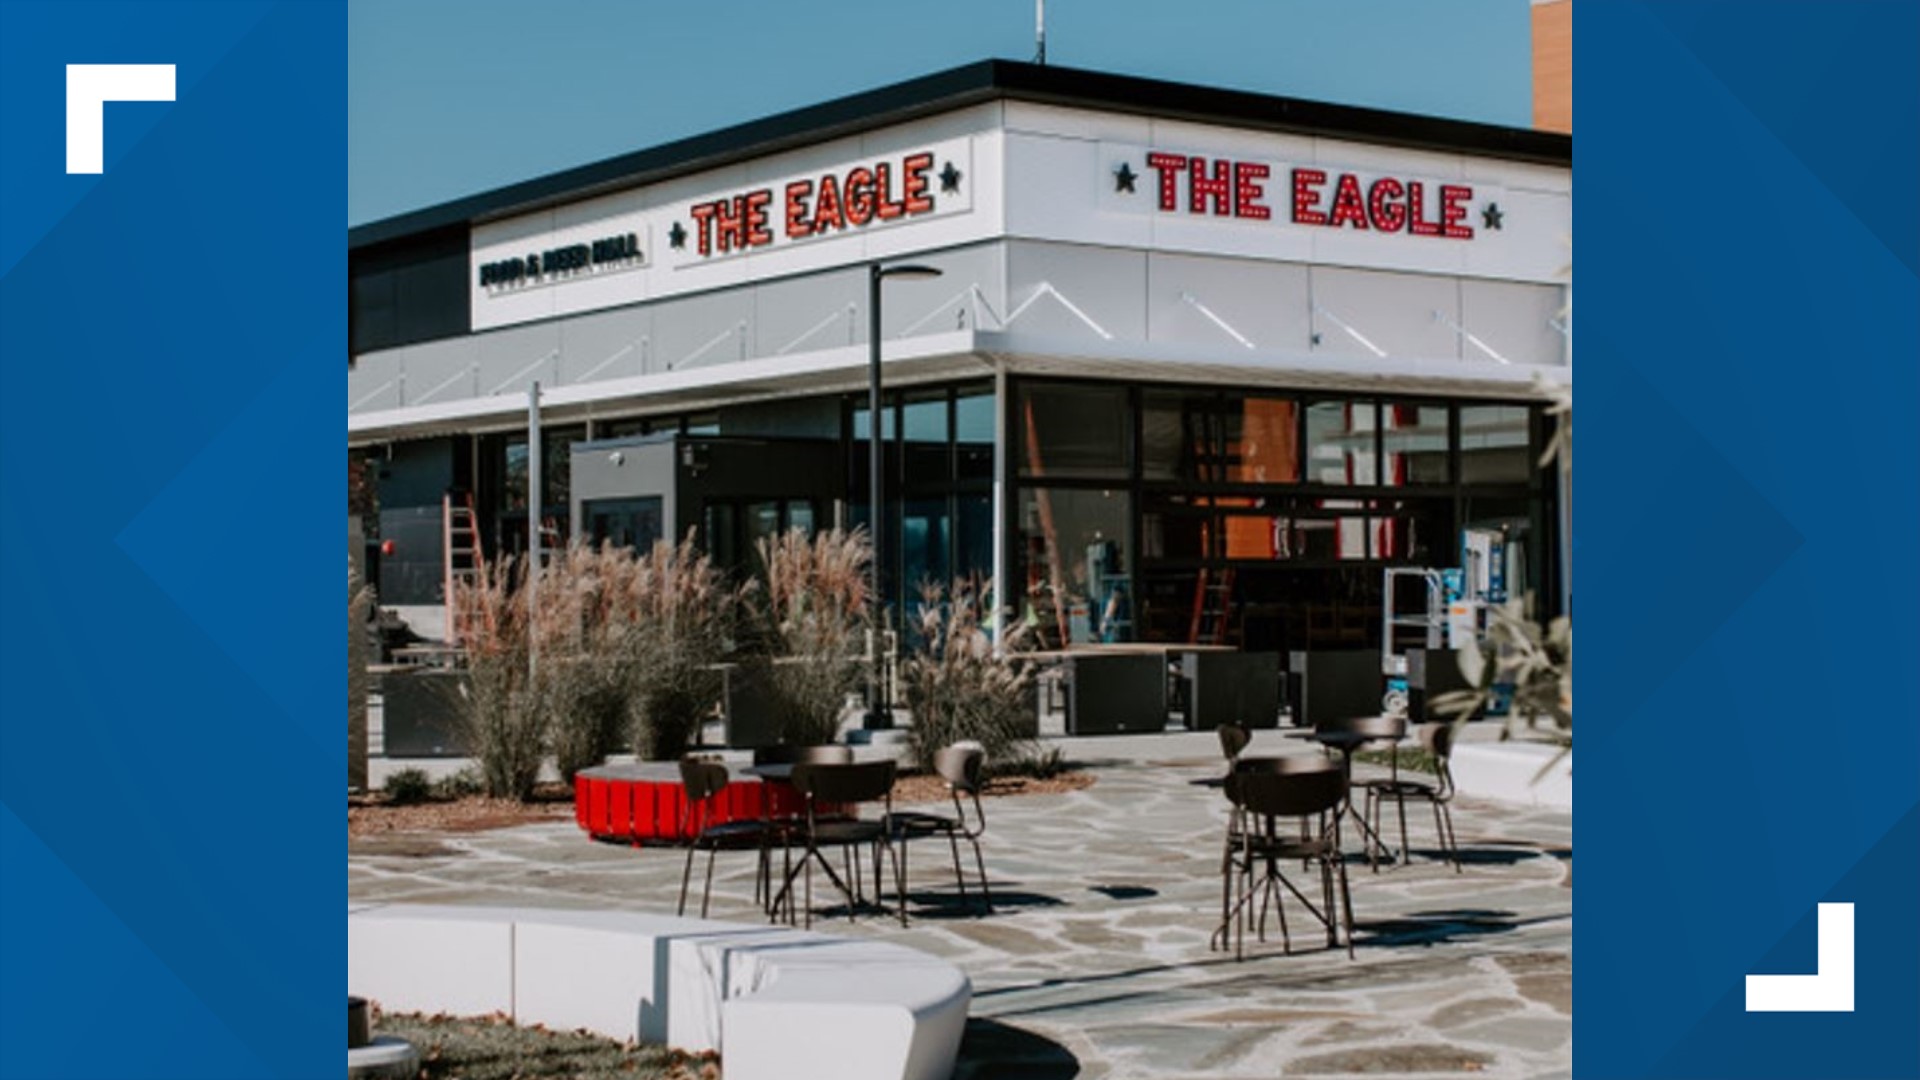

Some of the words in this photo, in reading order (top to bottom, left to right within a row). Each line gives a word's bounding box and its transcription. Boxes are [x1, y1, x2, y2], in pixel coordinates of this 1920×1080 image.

[691, 189, 772, 256] THE
[785, 153, 933, 239] EAGLE
[1147, 152, 1270, 219] THE
[1292, 167, 1474, 239] EAGLE
